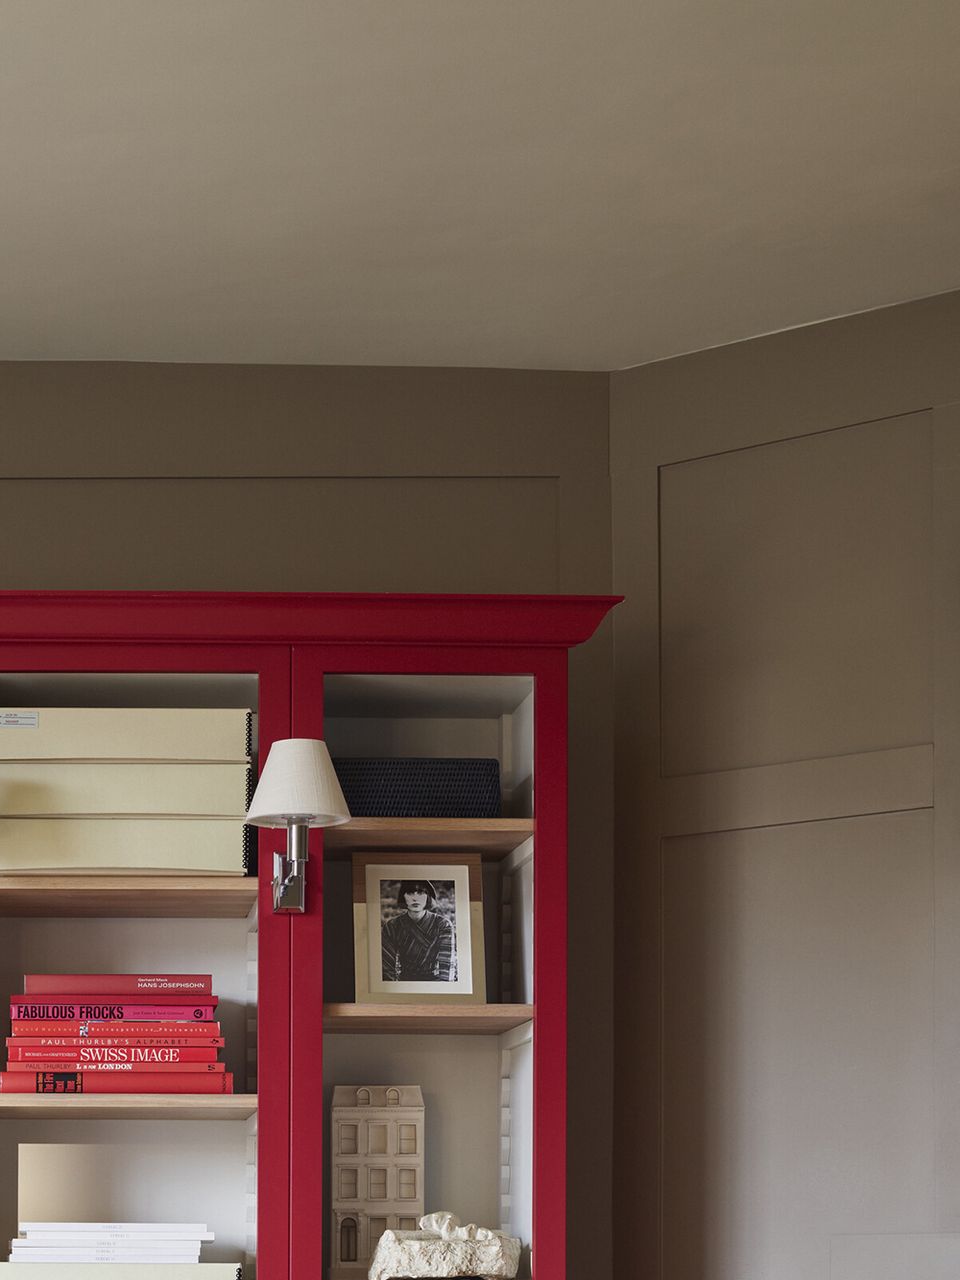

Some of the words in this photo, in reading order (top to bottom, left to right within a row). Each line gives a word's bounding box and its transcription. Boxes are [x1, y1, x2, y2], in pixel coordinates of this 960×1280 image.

[17, 1005, 75, 1019] FABULOUS
[79, 1005, 124, 1019] FROCKS
[80, 1047, 128, 1062] SWISS
[131, 1048, 180, 1062] IMAGE
